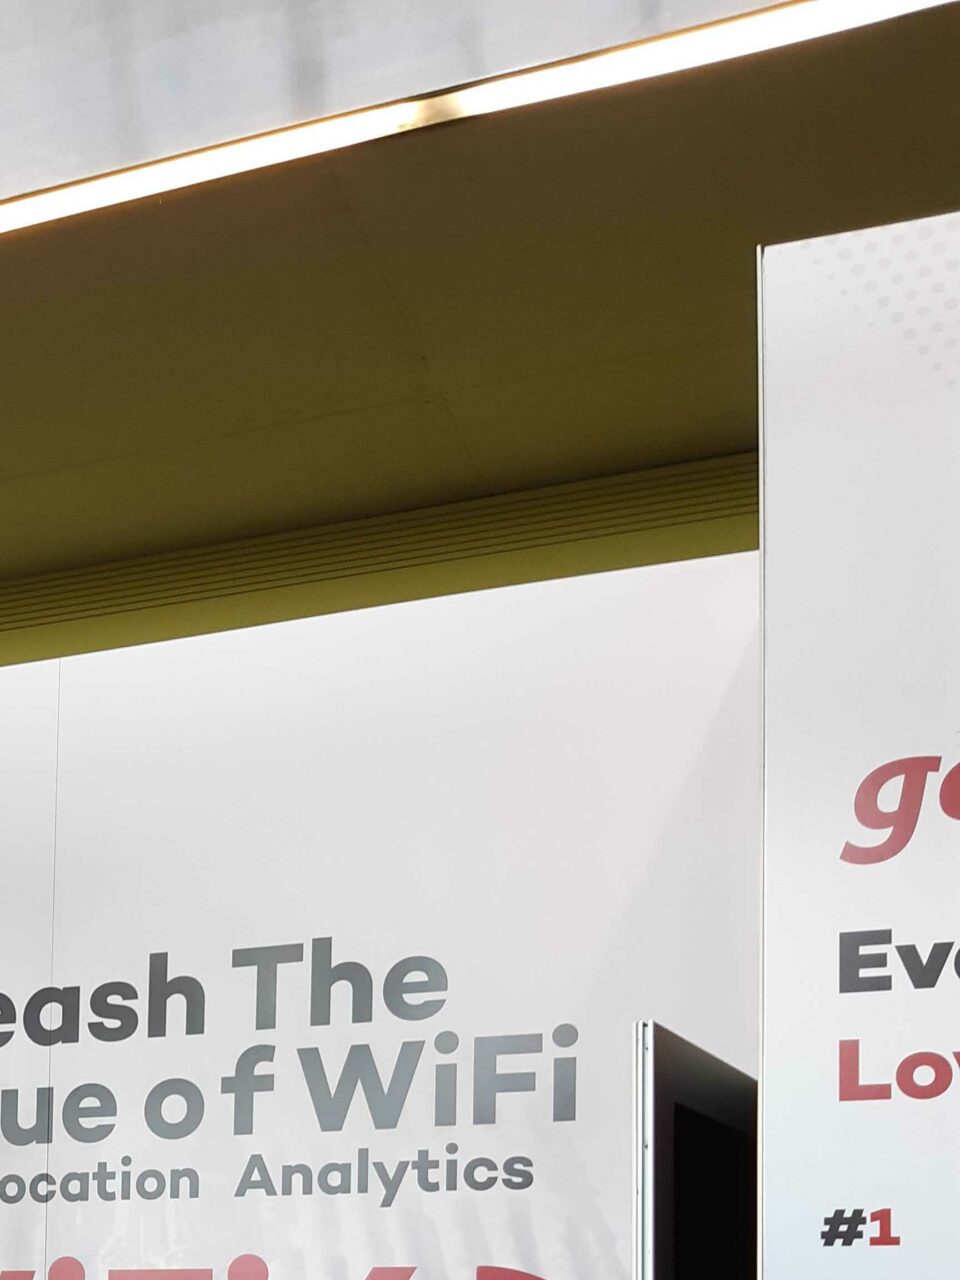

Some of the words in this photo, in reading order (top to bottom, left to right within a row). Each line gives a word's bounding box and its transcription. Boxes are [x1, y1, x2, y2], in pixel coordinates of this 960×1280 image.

[232, 937, 448, 1030] The
[839, 929, 960, 993] Ev
[145, 1045, 275, 1139] of
[297, 1023, 578, 1131] WiFi
[838, 1039, 960, 1101] Lo
[235, 1143, 534, 1207] Analytics
[821, 1208, 901, 1246] #1
